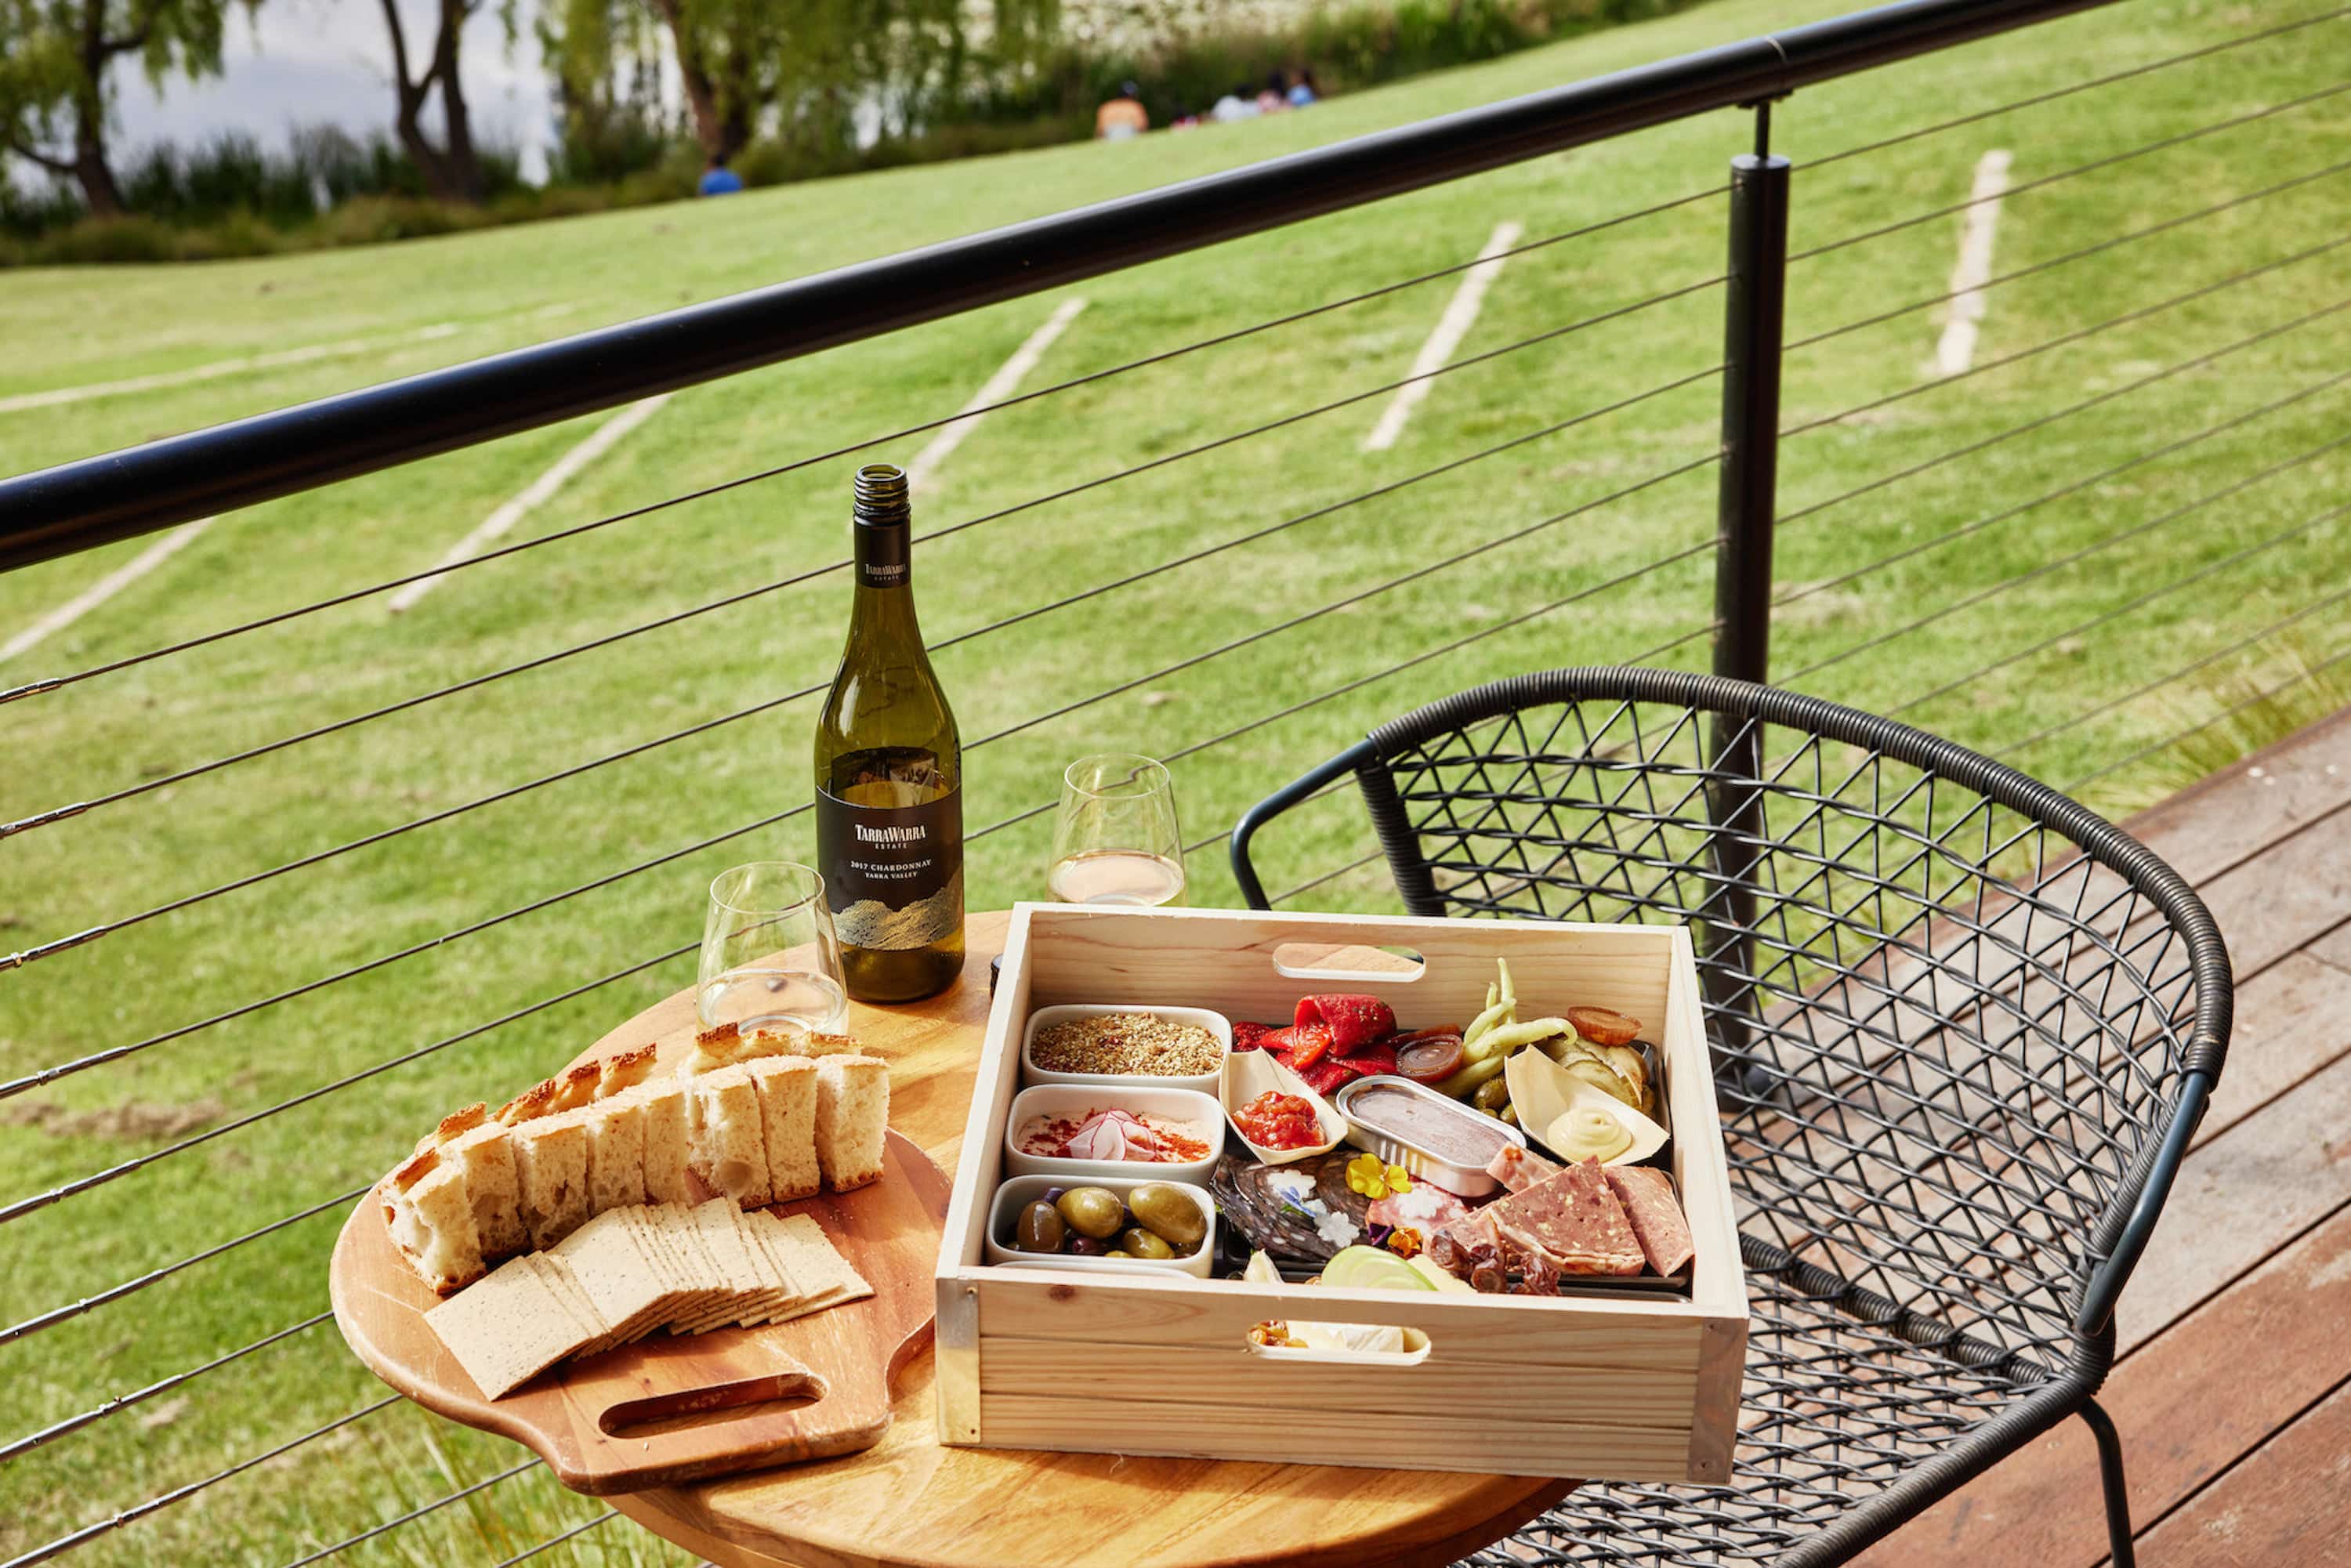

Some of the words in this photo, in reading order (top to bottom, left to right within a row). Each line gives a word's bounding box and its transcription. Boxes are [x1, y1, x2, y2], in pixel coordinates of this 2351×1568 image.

[854, 824, 926, 842] TARRAWARRA
[850, 860, 868, 870] 2017
[870, 859, 932, 871] CHARDONNAY
